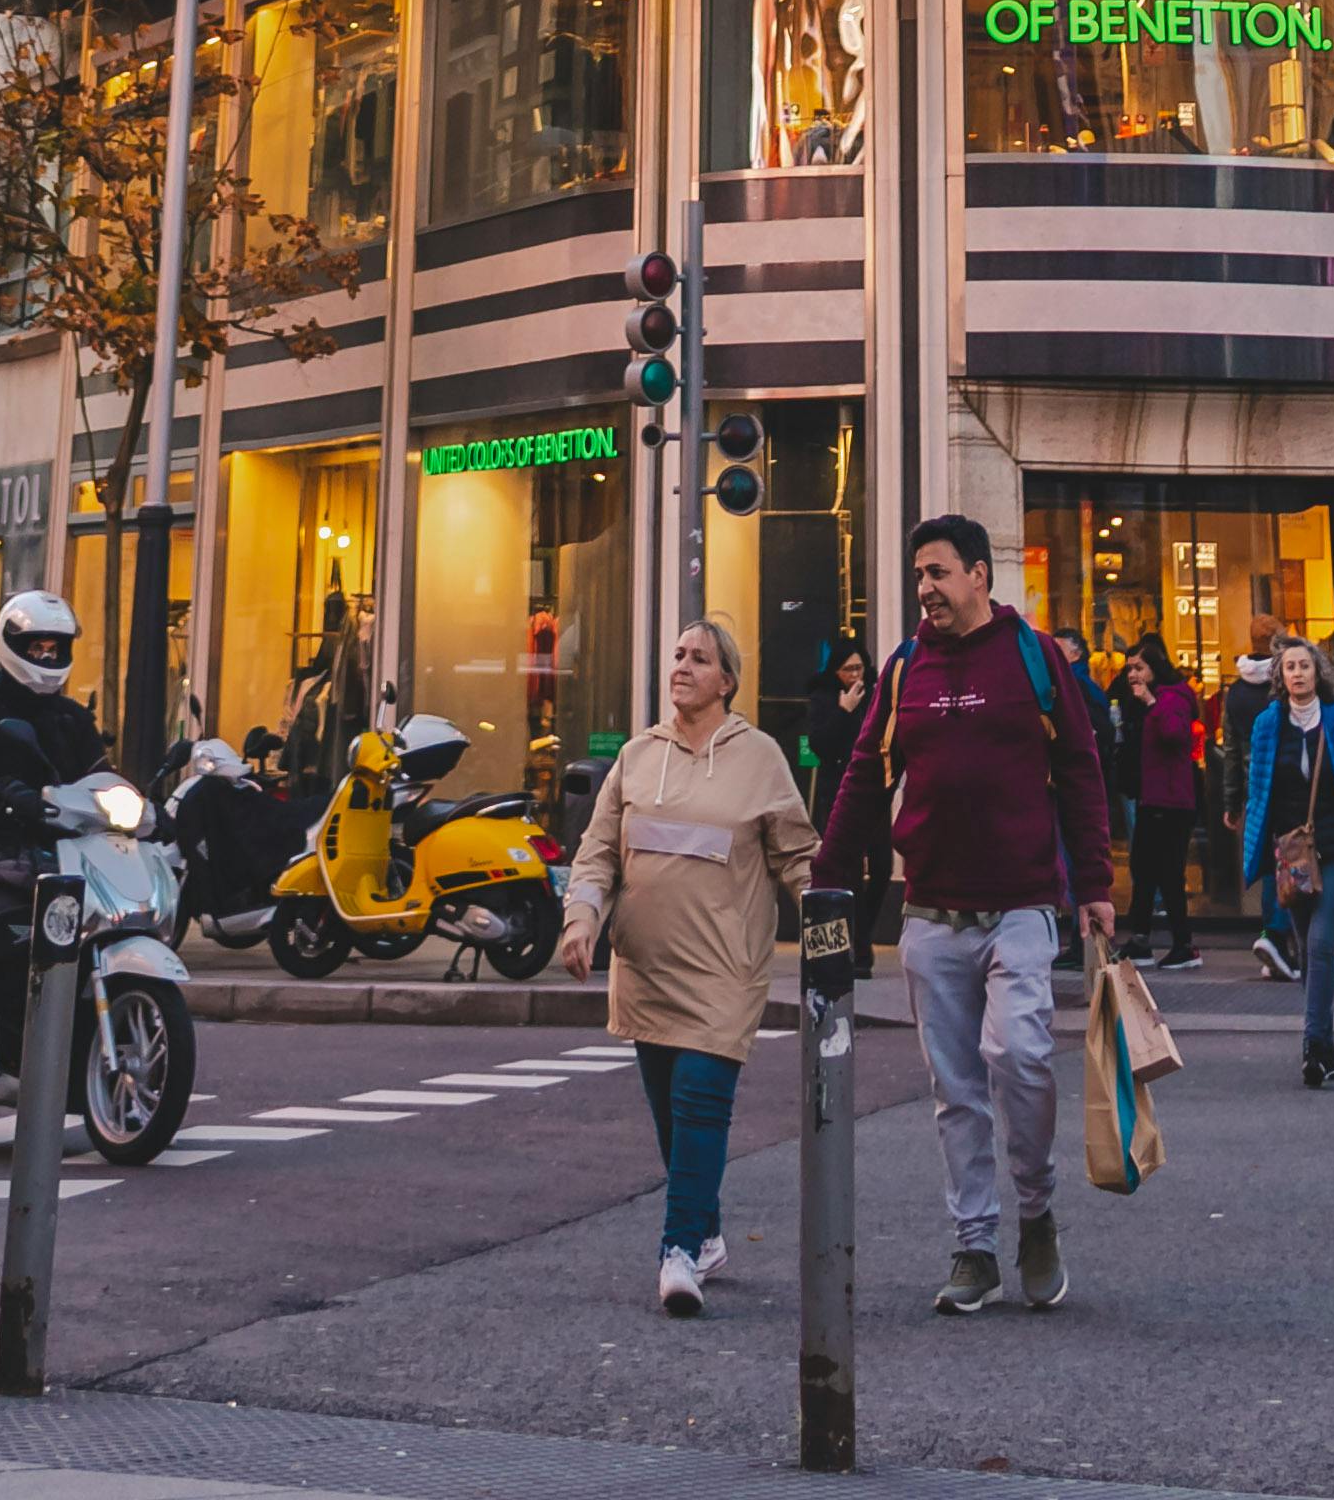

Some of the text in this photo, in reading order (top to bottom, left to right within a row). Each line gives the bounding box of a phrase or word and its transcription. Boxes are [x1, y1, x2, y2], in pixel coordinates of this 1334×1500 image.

[985, 0, 1333, 51] OF BENETTON.
[423, 443, 466, 476] UNITED
[467, 438, 515, 470] COLORS
[515, 436, 534, 467] OF
